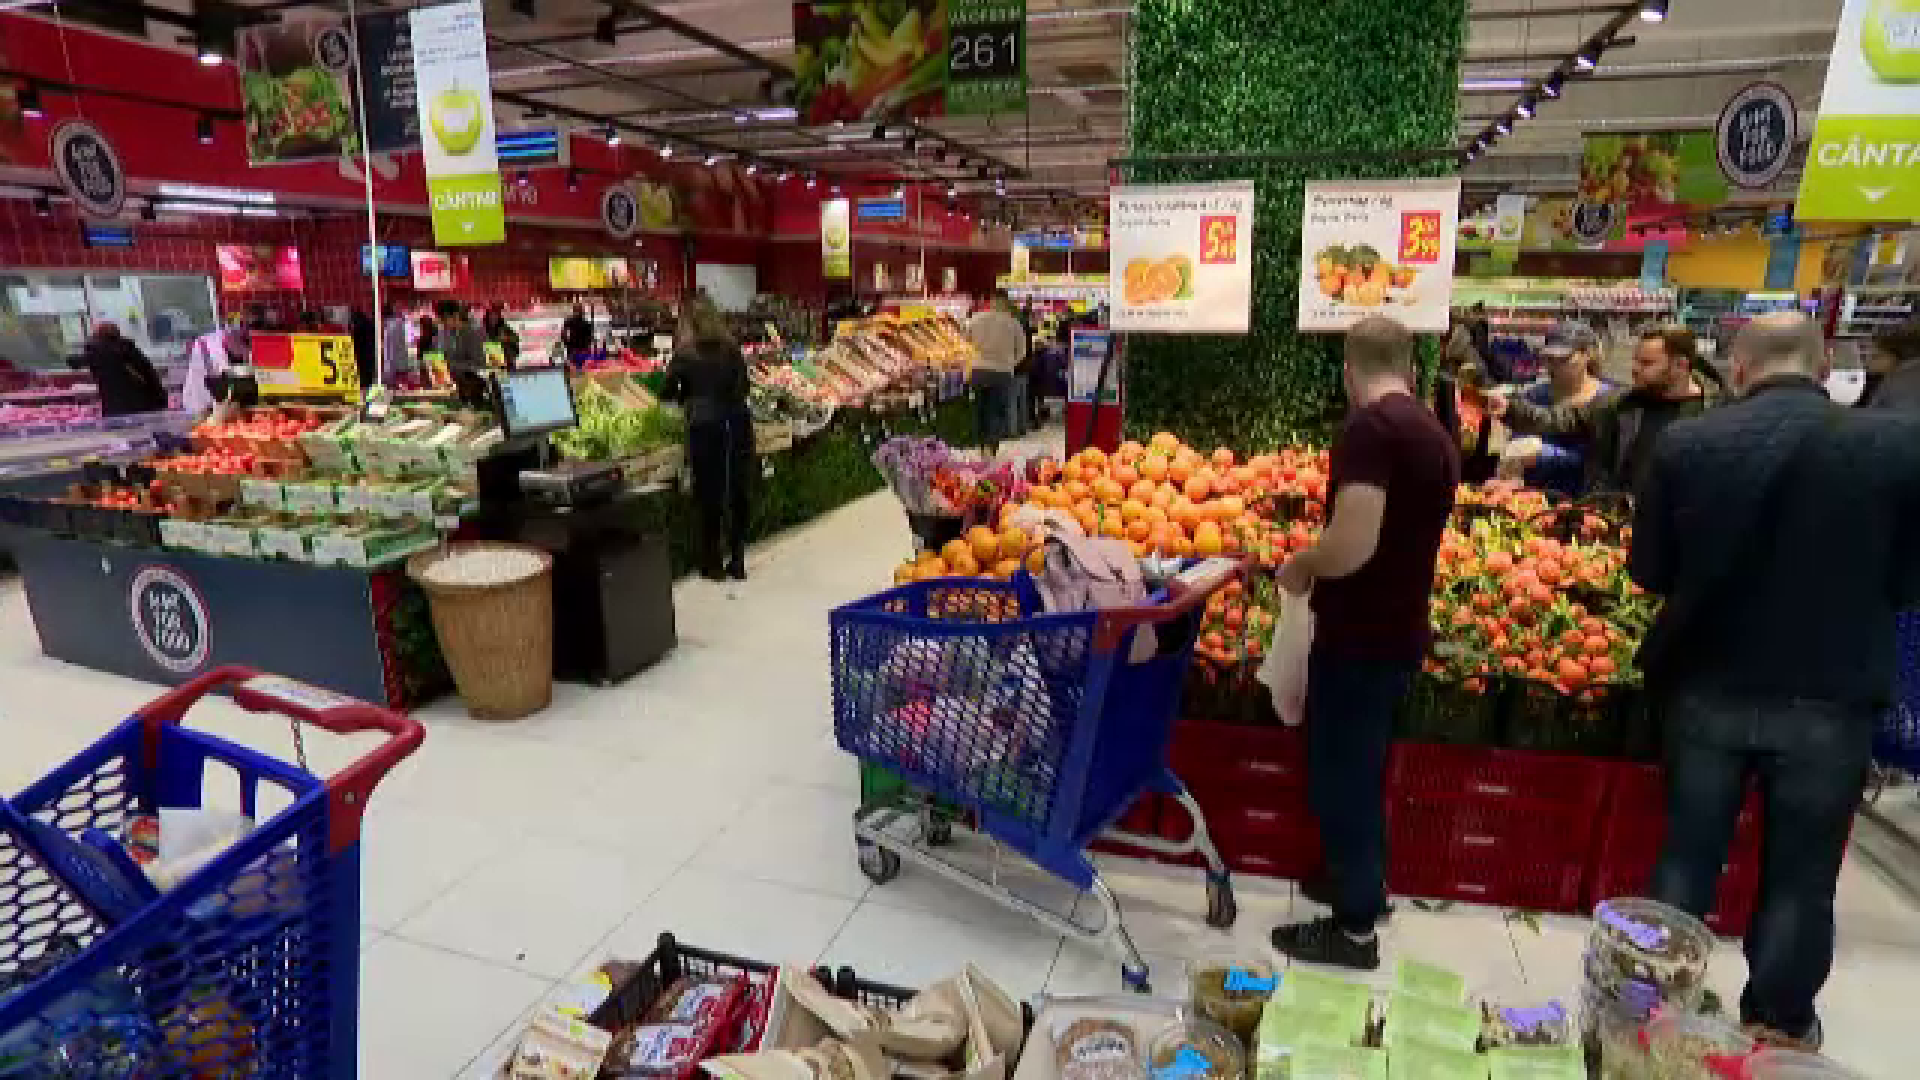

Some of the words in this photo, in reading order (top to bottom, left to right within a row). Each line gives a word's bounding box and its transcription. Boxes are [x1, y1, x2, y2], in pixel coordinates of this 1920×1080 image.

[950, 33, 1015, 70] 261
[1817, 131, 1920, 168] CÂNTA
[320, 341, 337, 385] 5
